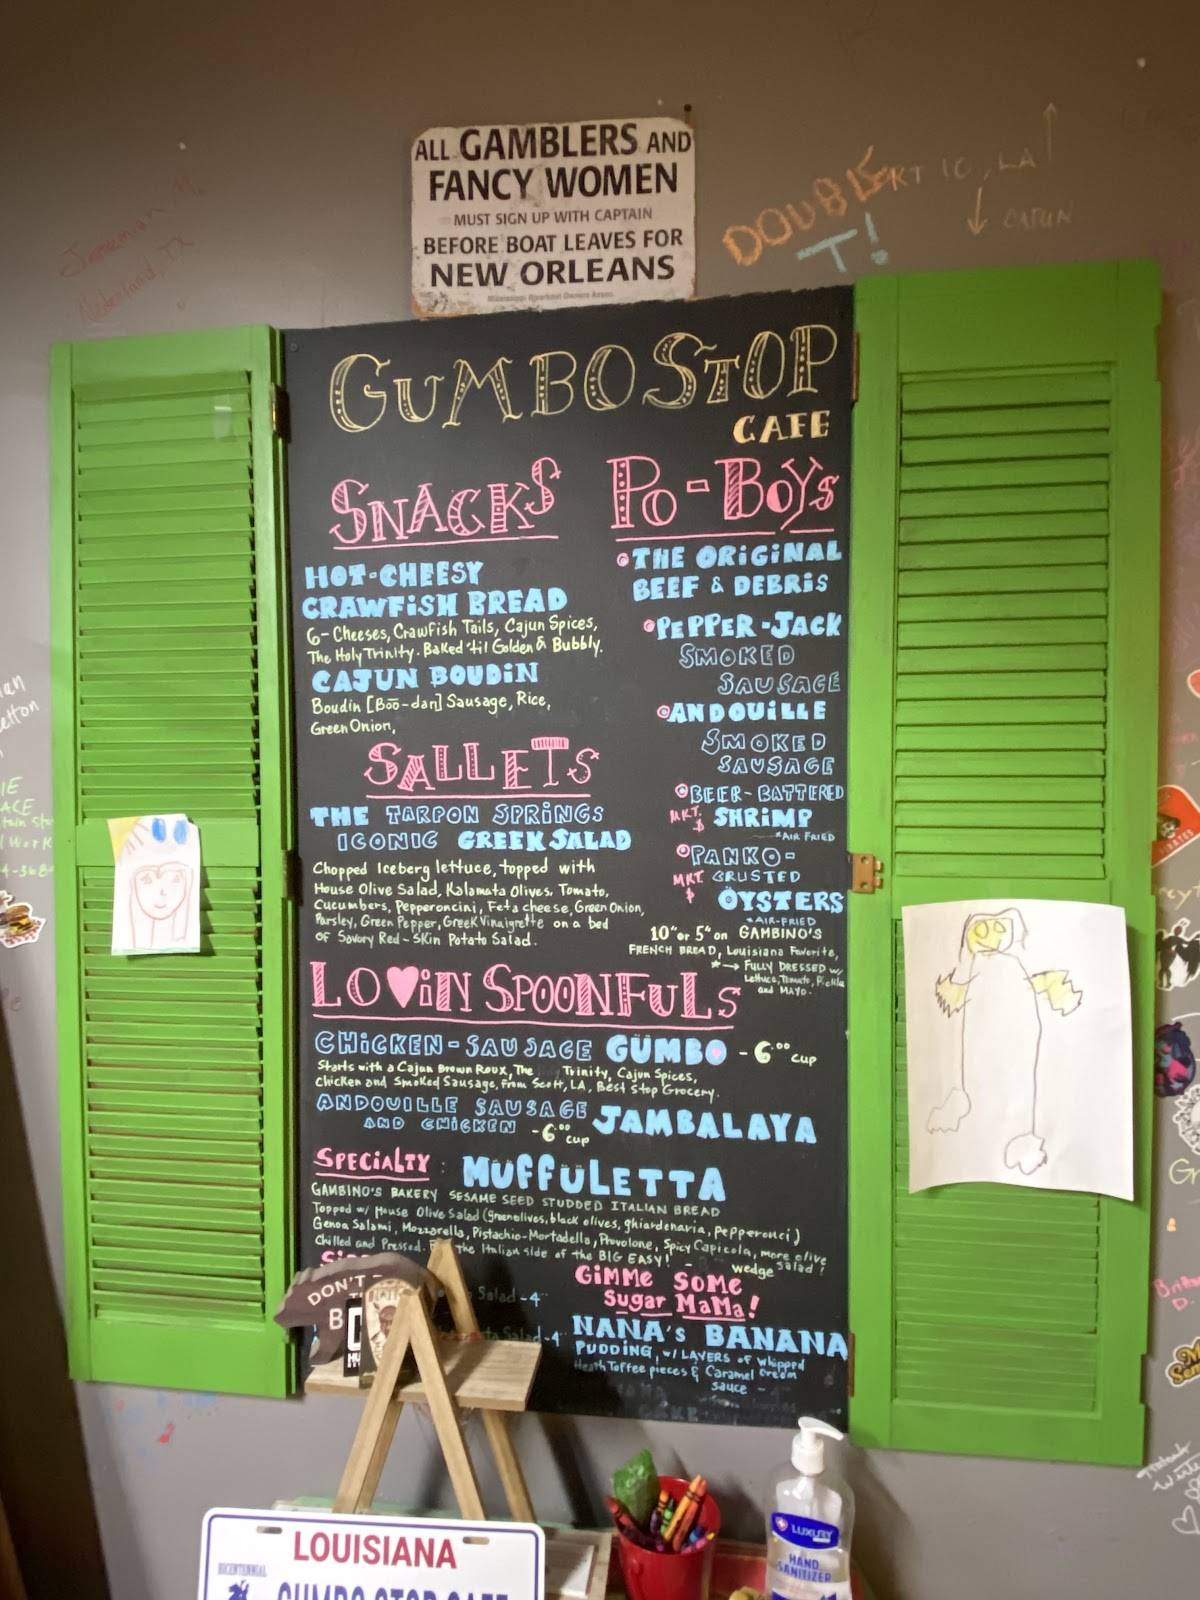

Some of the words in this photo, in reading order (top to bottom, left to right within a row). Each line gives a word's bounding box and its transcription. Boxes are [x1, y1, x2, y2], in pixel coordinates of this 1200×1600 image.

[415, 139, 450, 161] ALL
[460, 123, 638, 161] GAMBLERS
[647, 131, 691, 154] AND
[429, 168, 533, 201] FANCY
[545, 163, 678, 198] WOMEN
[453, 213, 491, 226] MUST
[496, 212, 527, 225] SIGN
[532, 211, 550, 224] UP
[554, 209, 590, 223] WITH
[594, 207, 652, 221] CAPTAIN
[424, 236, 498, 255] BEFORE
[506, 235, 556, 253] BOAT
[564, 231, 635, 251] LEAVES
[643, 228, 683, 248] FOR
[431, 262, 509, 287] NEW
[520, 255, 675, 286] ORLEANS
[329, 344, 636, 432] GUMBO
[732, 410, 831, 444] CAFE
[329, 456, 562, 544] SNACKS
[632, 546, 685, 570] THE
[632, 575, 700, 601] BEEF
[711, 576, 724, 594] &
[467, 587, 568, 616] BREAD
[504, 618, 545, 638] Cajun
[307, 650, 332, 665] The
[335, 649, 363, 667] Holy
[423, 642, 463, 658] Baked
[492, 638, 533, 654] Golden
[679, 643, 795, 668] SMOKED
[311, 668, 419, 693] CAJUN
[717, 671, 841, 695] SAUSAGE
[311, 696, 361, 715] Boudin
[310, 721, 348, 735] Green
[702, 728, 827, 755] SMOKED
[717, 755, 835, 776] SAUSAGE
[310, 806, 369, 827] THE
[386, 805, 481, 825] TARPON
[337, 831, 439, 851] ICONIC
[457, 830, 546, 851] GREEK
[549, 828, 632, 851] SALAD
[312, 861, 368, 881] Chopped
[377, 862, 430, 882] Iceberg
[498, 857, 548, 880] topped
[559, 858, 596, 874] with
[712, 870, 801, 884] CRUSTED
[314, 883, 354, 895] House
[359, 882, 393, 897] Olive
[574, 900, 607, 913] Green
[360, 914, 394, 928] Green
[588, 916, 609, 930] bed
[338, 931, 374, 948] Savory
[628, 945, 672, 955] FRENCH
[778, 961, 826, 973] DRESSED
[317, 1060, 354, 1072] Starts
[358, 1061, 383, 1073] with
[397, 1061, 433, 1077] Cajun
[513, 1063, 534, 1076] The
[617, 1067, 651, 1082] Cajun
[315, 1076, 362, 1088] Chicken
[365, 1077, 387, 1088] and
[596, 1082, 626, 1095] Best
[317, 1093, 458, 1113] ANDOUILLE
[592, 1105, 817, 1144] JAMBALAYA
[363, 1116, 405, 1130] AND
[391, 1187, 438, 1202] BAKERY
[449, 1190, 497, 1203] SESAME
[502, 1194, 534, 1206] SEED
[543, 1198, 603, 1211] STUDDED
[673, 1205, 721, 1217] BREAD
[599, 1252, 623, 1263] BIG
[731, 1264, 774, 1280] wedge
[307, 1275, 366, 1306] DON'T
[705, 1324, 848, 1360] BANANA
[681, 1350, 730, 1364] LAYERS
[705, 1365, 754, 1380] Caramel
[293, 1531, 458, 1569] LOUISIANA
[789, 1553, 819, 1569] HAND
